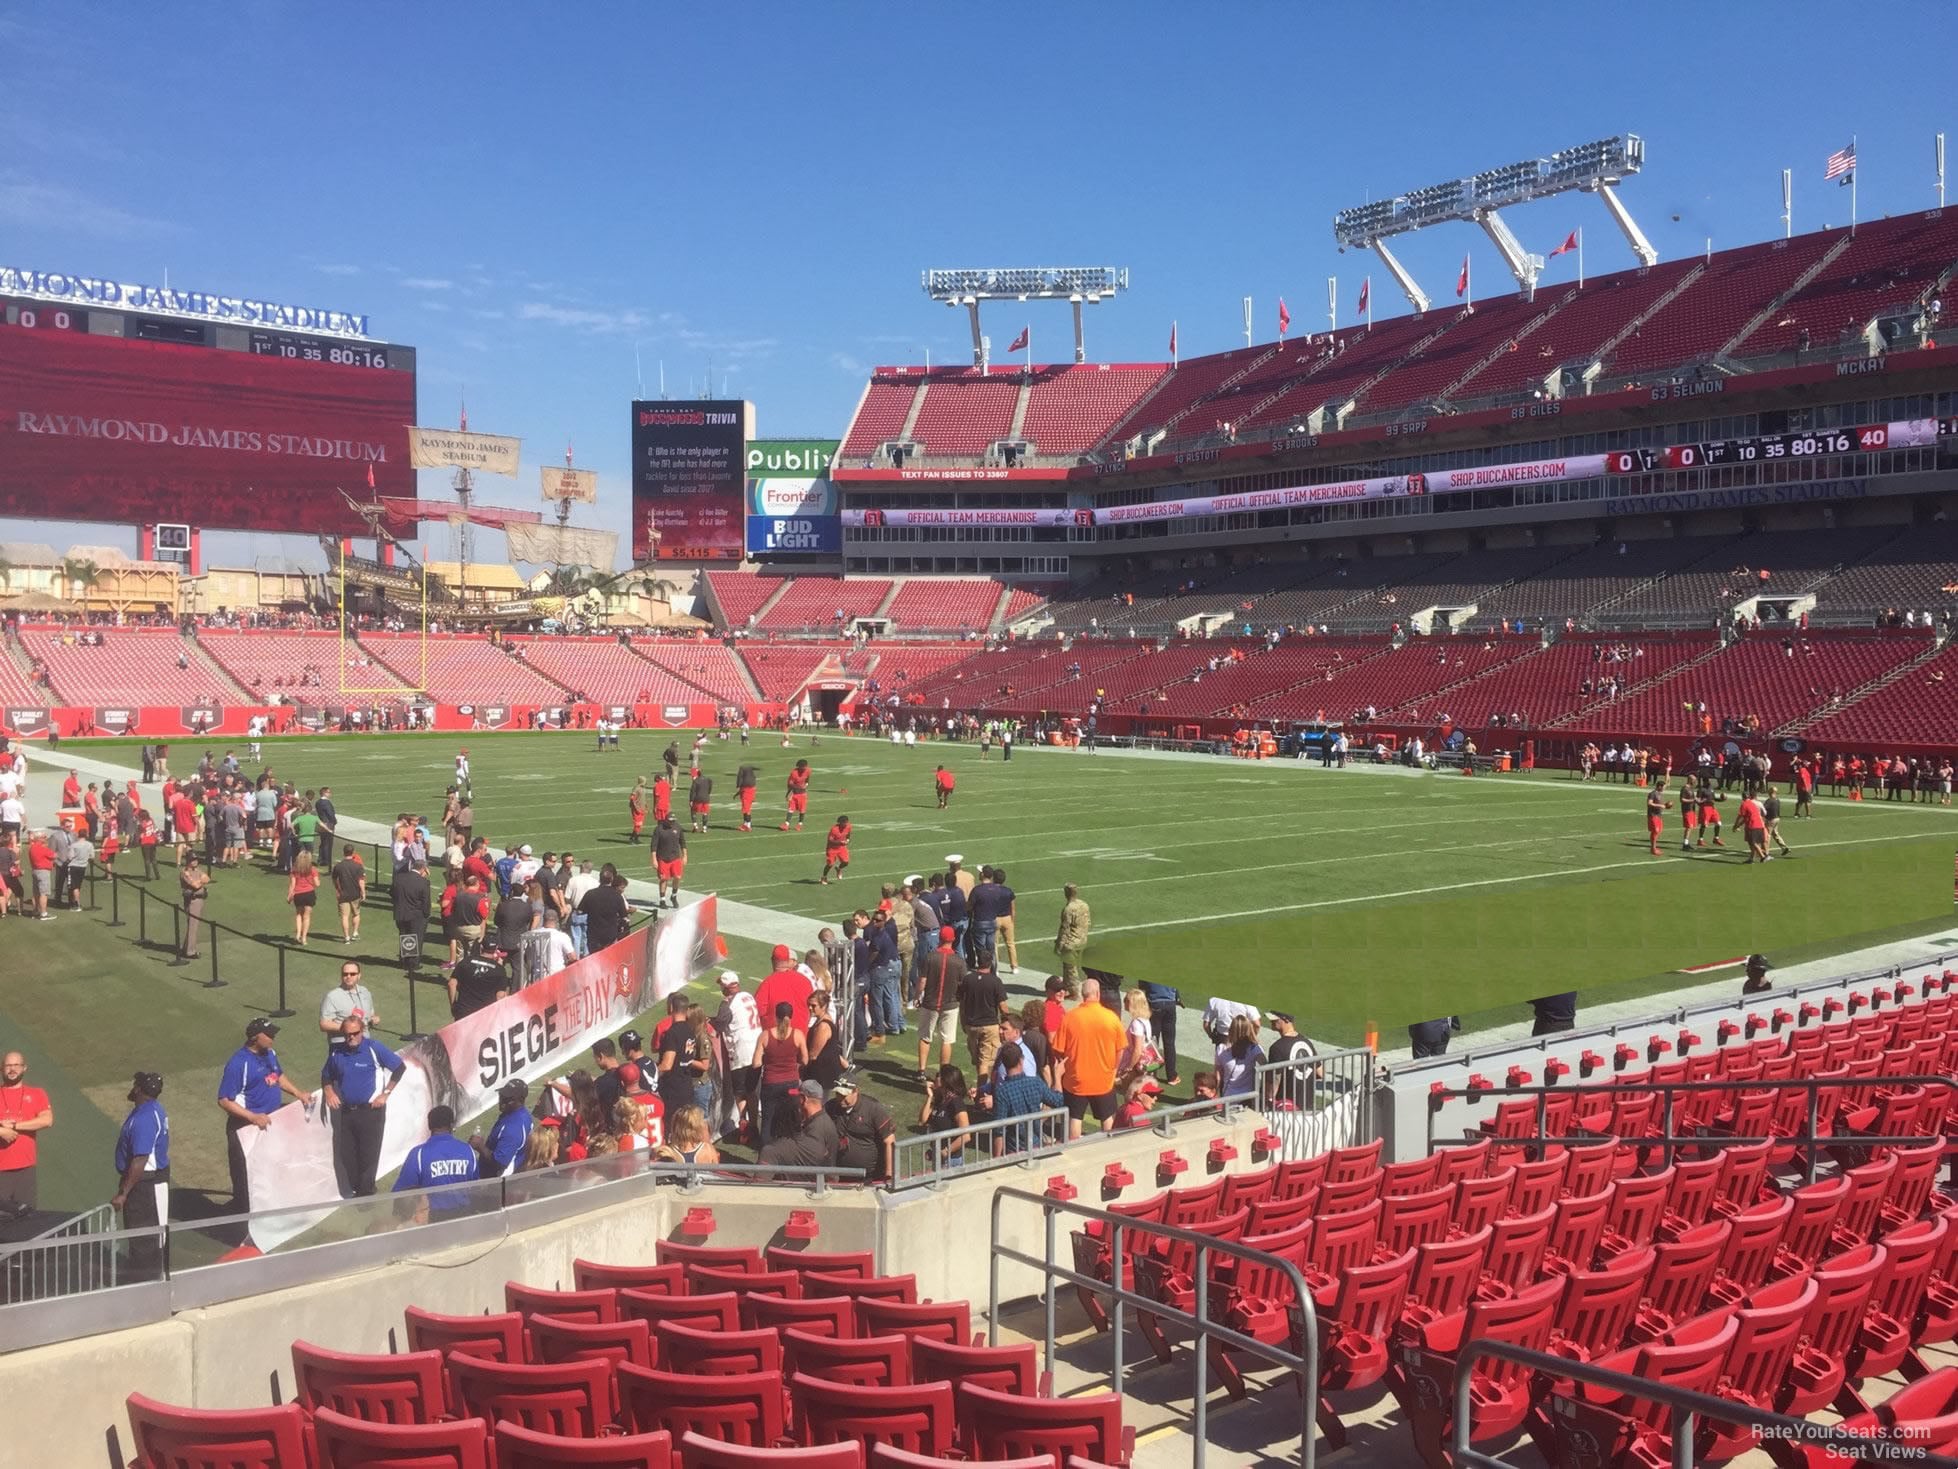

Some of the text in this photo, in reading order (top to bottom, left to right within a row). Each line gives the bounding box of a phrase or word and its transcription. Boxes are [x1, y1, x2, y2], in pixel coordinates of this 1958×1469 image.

[128, 284, 233, 317] JAMES
[241, 299, 370, 335] STADIUM
[21, 311, 35, 328] 0
[55, 312, 69, 329] 0
[254, 342, 271, 354] 1ST
[280, 345, 297, 358] 10
[304, 349, 321, 361] 35
[329, 349, 386, 369] 80:16
[1837, 357, 1887, 376] MCKAY
[1652, 379, 1723, 400] 63 SELMON
[705, 413, 737, 424] TRIVIA
[1511, 403, 1561, 418] 88 GILES
[18, 411, 388, 462] RAYMOND JAMES STADIUM
[1386, 421, 1428, 436] 99 SAPP
[1286, 436, 1318, 450] BROOKS
[1861, 429, 1885, 445] 40
[421, 438, 509, 455] RAYMOND JAMES
[1738, 446, 1755, 460] 10
[1765, 443, 1785, 458] 35
[1791, 435, 1850, 456] 80:16
[443, 451, 487, 462] STADIUM
[748, 449, 833, 470] Publix
[1620, 455, 1632, 471] 0
[1681, 448, 1694, 465] 0
[1707, 449, 1724, 462] 1ST
[1450, 462, 1566, 487] SHOP.BUCCANEERS.COM
[767, 488, 823, 502] Frontier
[1250, 494, 1281, 507] OFFICIAL
[1284, 490, 1307, 502] TEAM
[1309, 483, 1367, 501] MERCHANDISE
[1606, 480, 1867, 514] RAYMOND JAMES STADIUM
[907, 512, 1037, 523] OFFICIAL TEAM MERCHANDISE
[1109, 502, 1184, 521] SHOP.BUCCANEERS.COM
[774, 520, 813, 534] BUD
[160, 529, 186, 545] 40
[767, 534, 820, 548] LIGHT
[672, 548, 710, 558] $5,115
[478, 975, 611, 1088] SIEGE THE DAY
[431, 1159, 470, 1178] SENTRY
